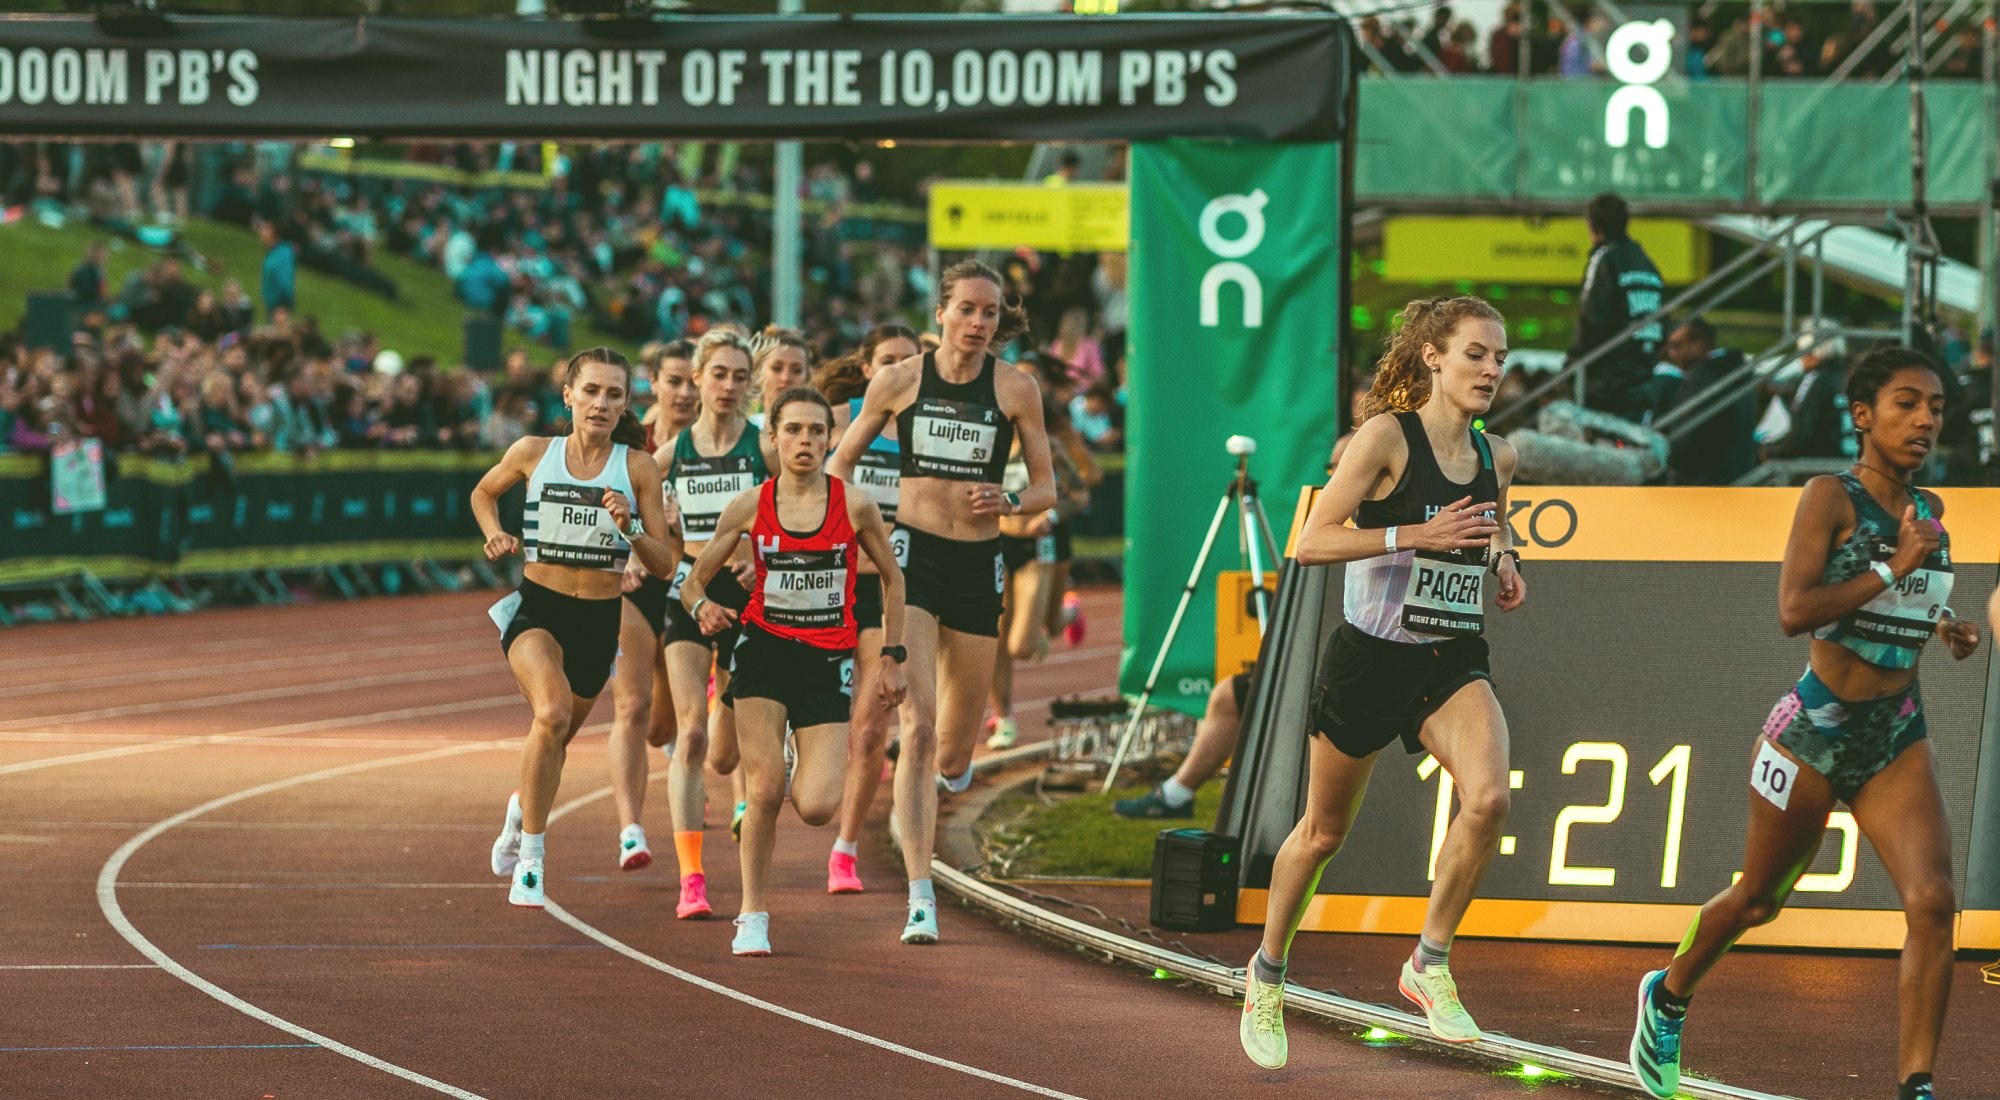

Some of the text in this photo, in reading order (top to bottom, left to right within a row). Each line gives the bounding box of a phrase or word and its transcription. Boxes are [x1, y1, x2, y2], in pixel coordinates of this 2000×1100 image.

[145, 49, 259, 106] PB'S
[505, 49, 1238, 112] NIGHT OF THE 10,000M PB'S
[929, 420, 980, 443] Luijten
[972, 448, 987, 460] 53
[687, 476, 741, 495] Goodall
[562, 506, 598, 527] Reid
[600, 533, 614, 547] 72
[780, 572, 834, 590] McNeil
[1415, 567, 1480, 605] PACER
[1895, 573, 1930, 597] Ayel
[828, 592, 840, 606] 59
[1928, 604, 1939, 619] 6
[1762, 760, 1787, 793] 10
